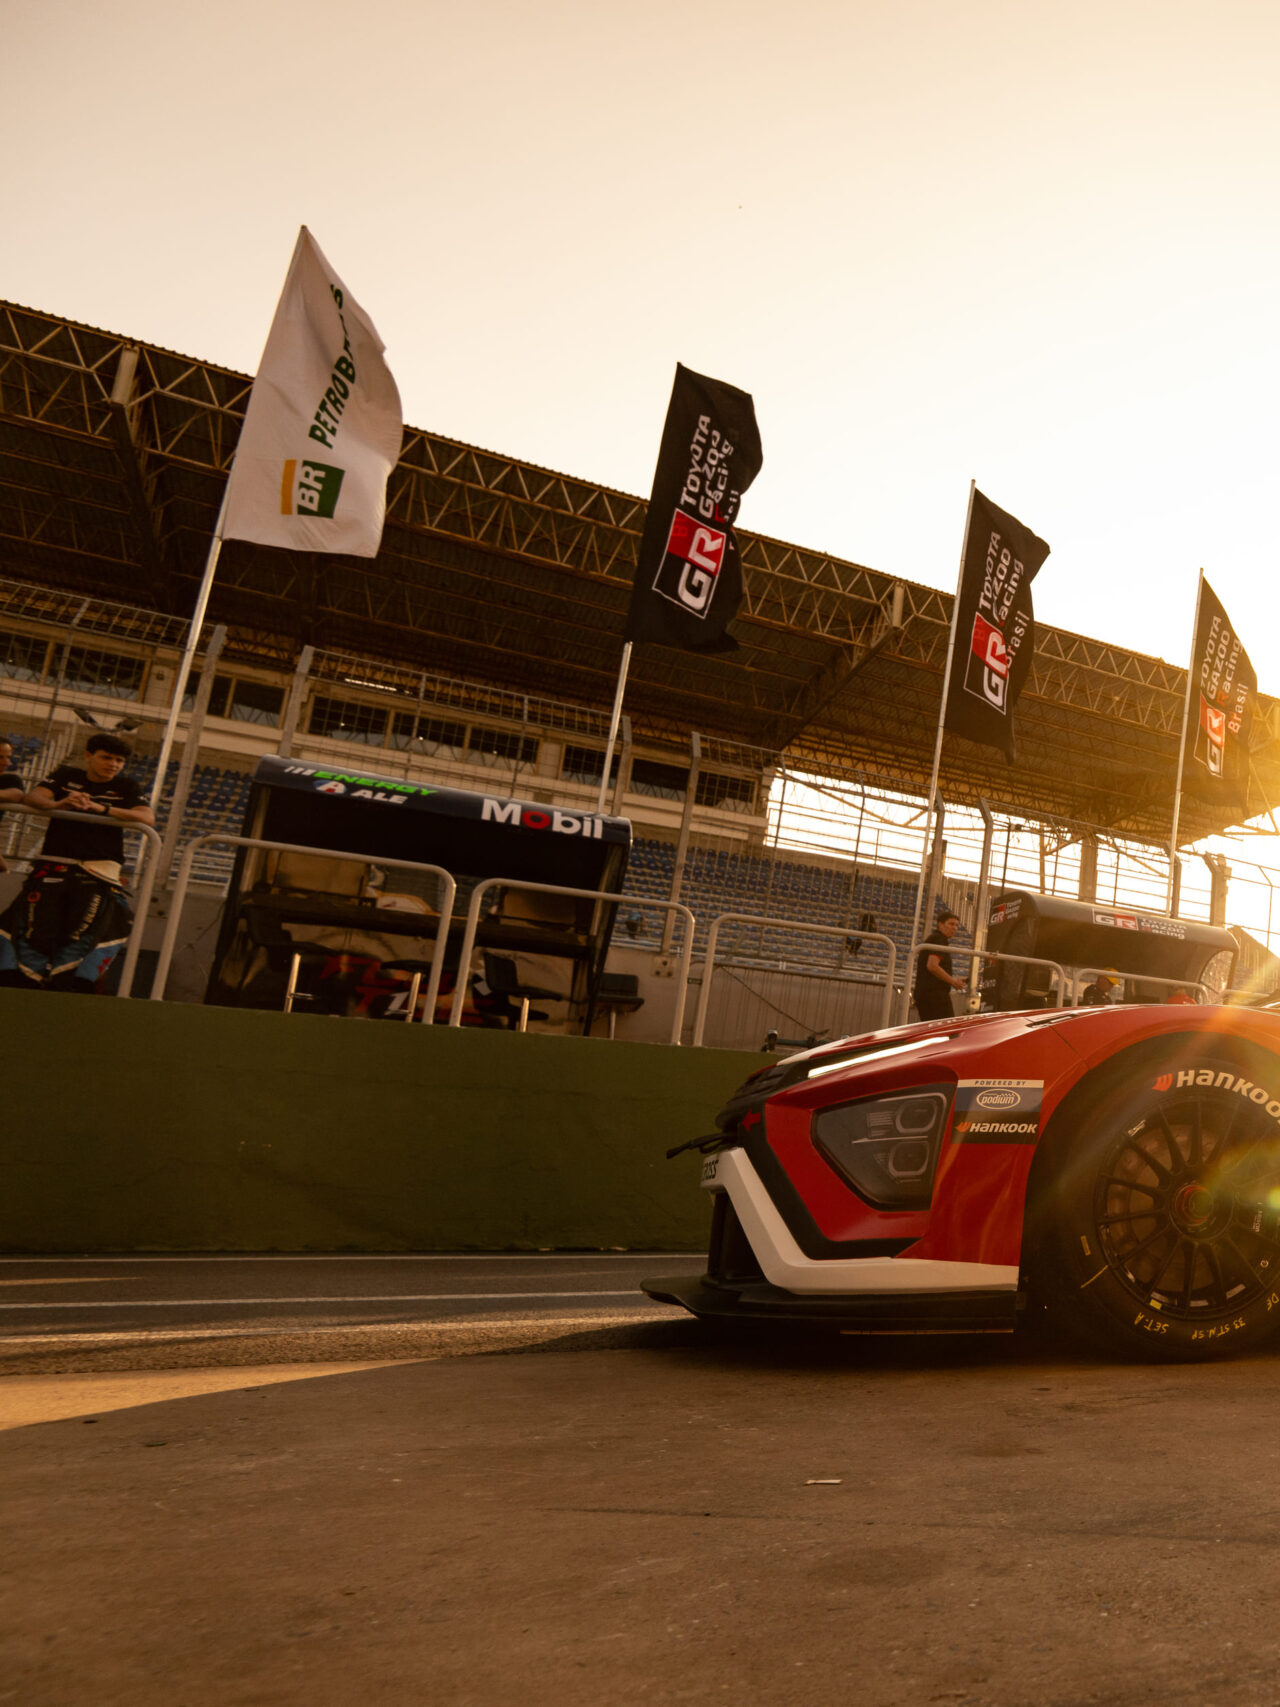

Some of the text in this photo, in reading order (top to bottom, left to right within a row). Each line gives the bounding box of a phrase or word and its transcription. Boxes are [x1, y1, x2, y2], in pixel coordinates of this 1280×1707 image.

[309, 284, 356, 449] PETROBS
[298, 464, 326, 512] BR
[680, 414, 711, 506] TOYOTA
[677, 527, 724, 611] GR
[979, 531, 1001, 612] TOYOTA
[999, 559, 1024, 627] acing
[983, 631, 1008, 707] GR
[1207, 630, 1231, 700] GAZOO
[1216, 638, 1244, 707] Racing
[1206, 707, 1224, 774] GR
[1228, 683, 1249, 735] Brasil
[312, 771, 440, 796] ENERGY
[351, 788, 409, 805] ALE
[481, 798, 603, 840] Mobil
[1095, 914, 1137, 930] GR
[1140, 922, 1185, 934] GAZOO
[981, 1094, 1015, 1105] podium
